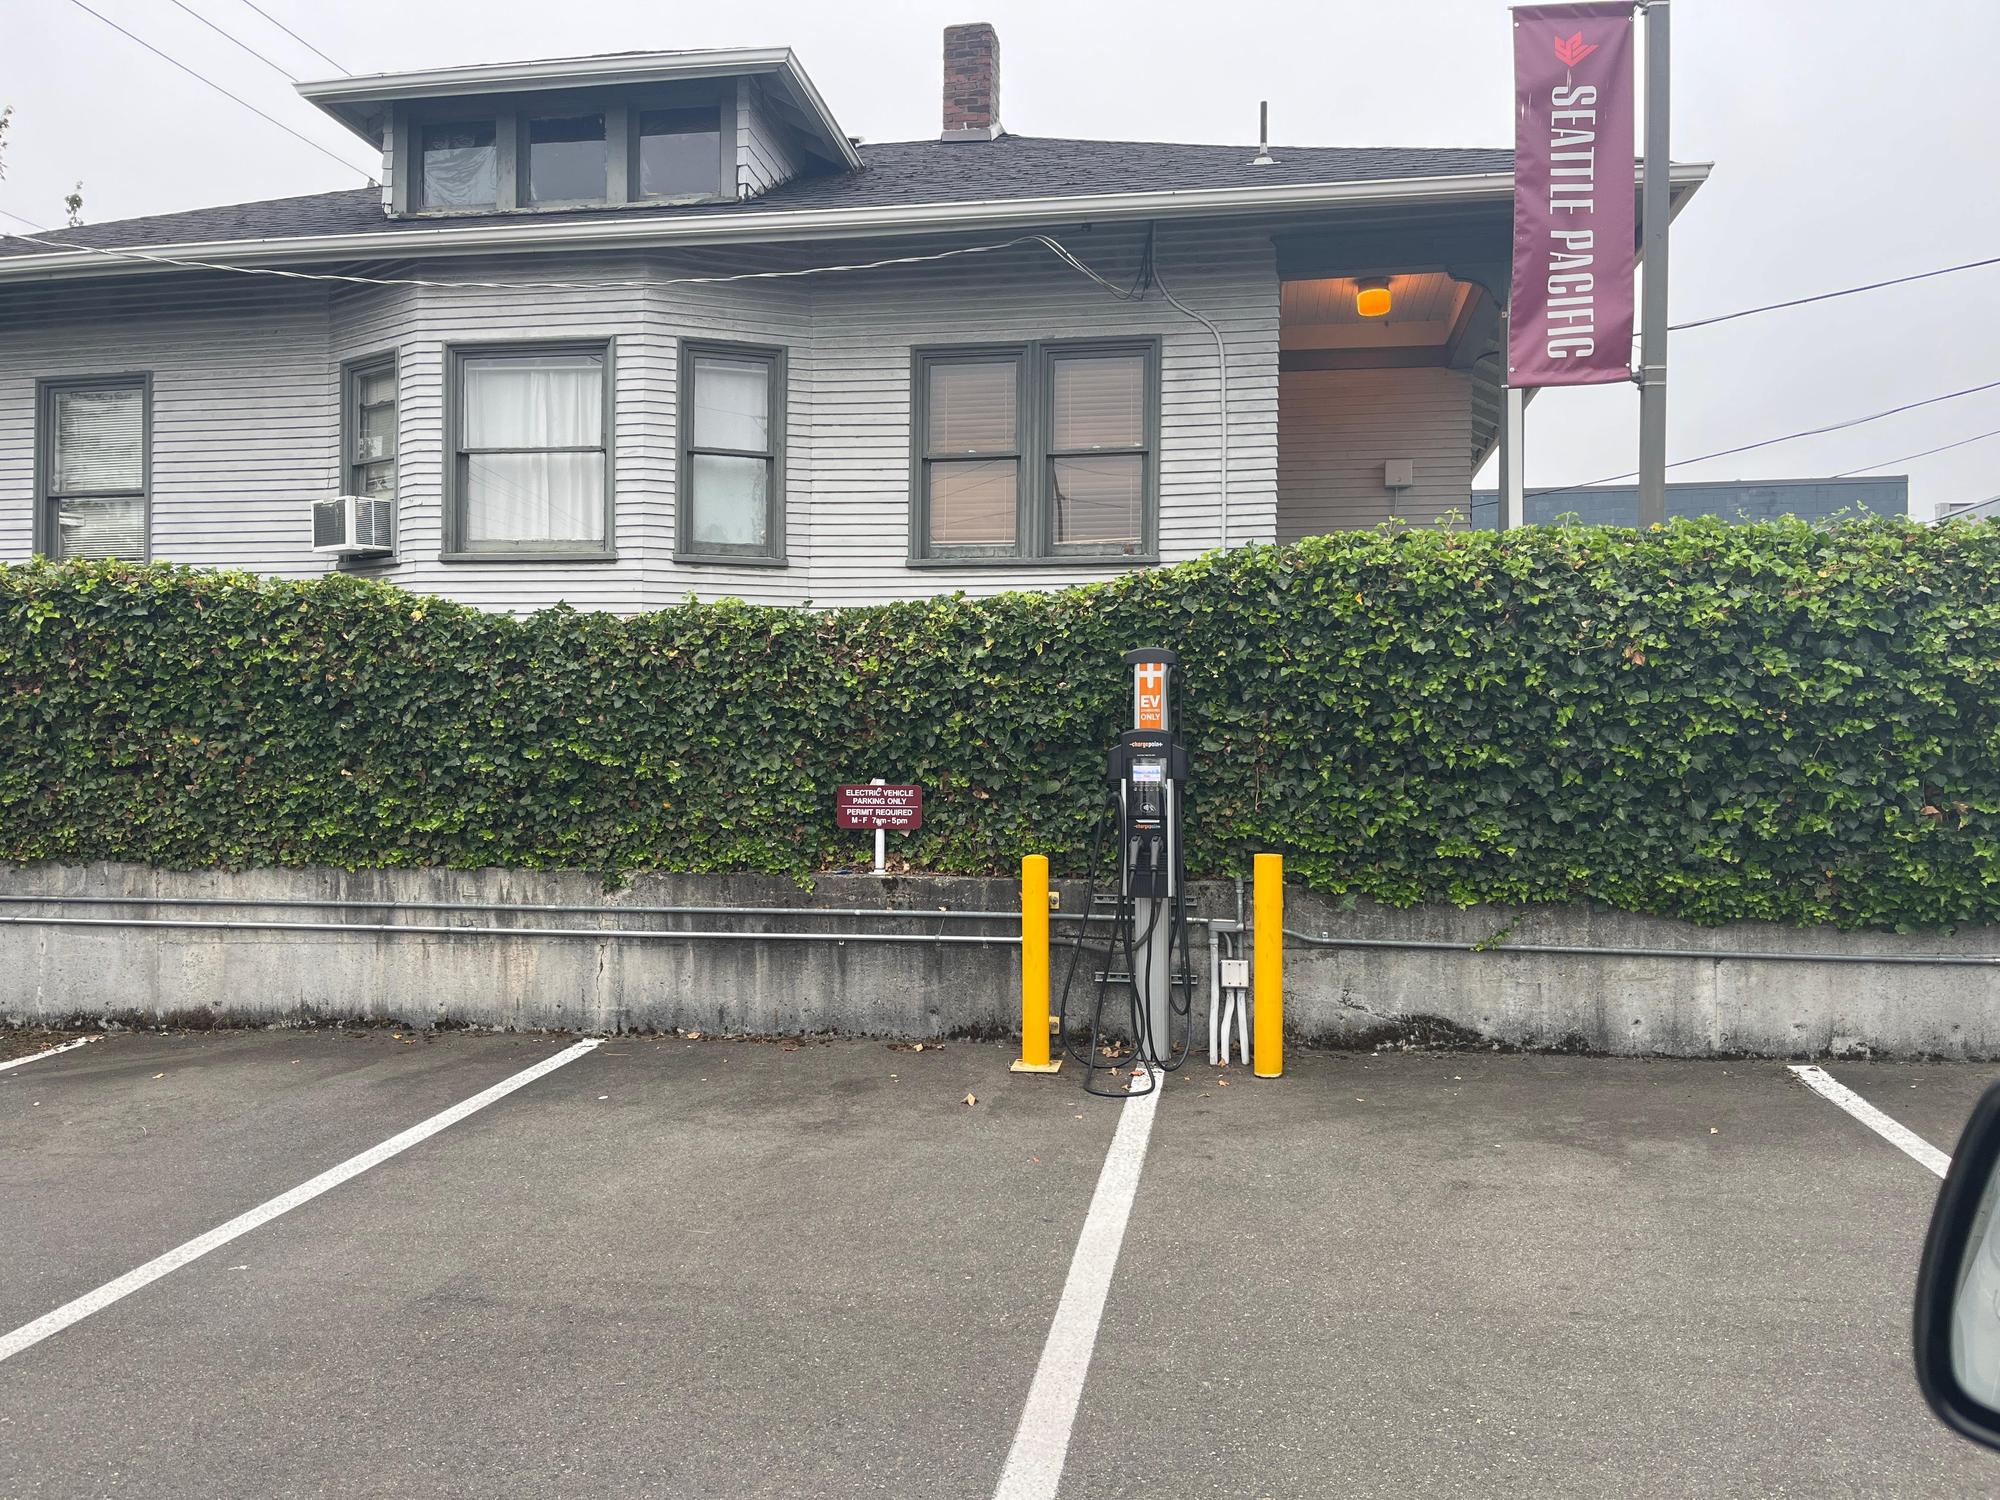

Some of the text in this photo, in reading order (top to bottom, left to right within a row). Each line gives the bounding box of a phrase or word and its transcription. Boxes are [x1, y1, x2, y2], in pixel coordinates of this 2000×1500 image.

[1547, 85, 1597, 358] SEATTLE PACIFIC
[1140, 695, 1160, 707] EV
[1140, 713, 1160, 721] ONLY
[846, 789, 914, 797] ELECTRIC VEHICLE
[852, 797, 885, 805] PARKING
[846, 808, 873, 816] PERMIT
